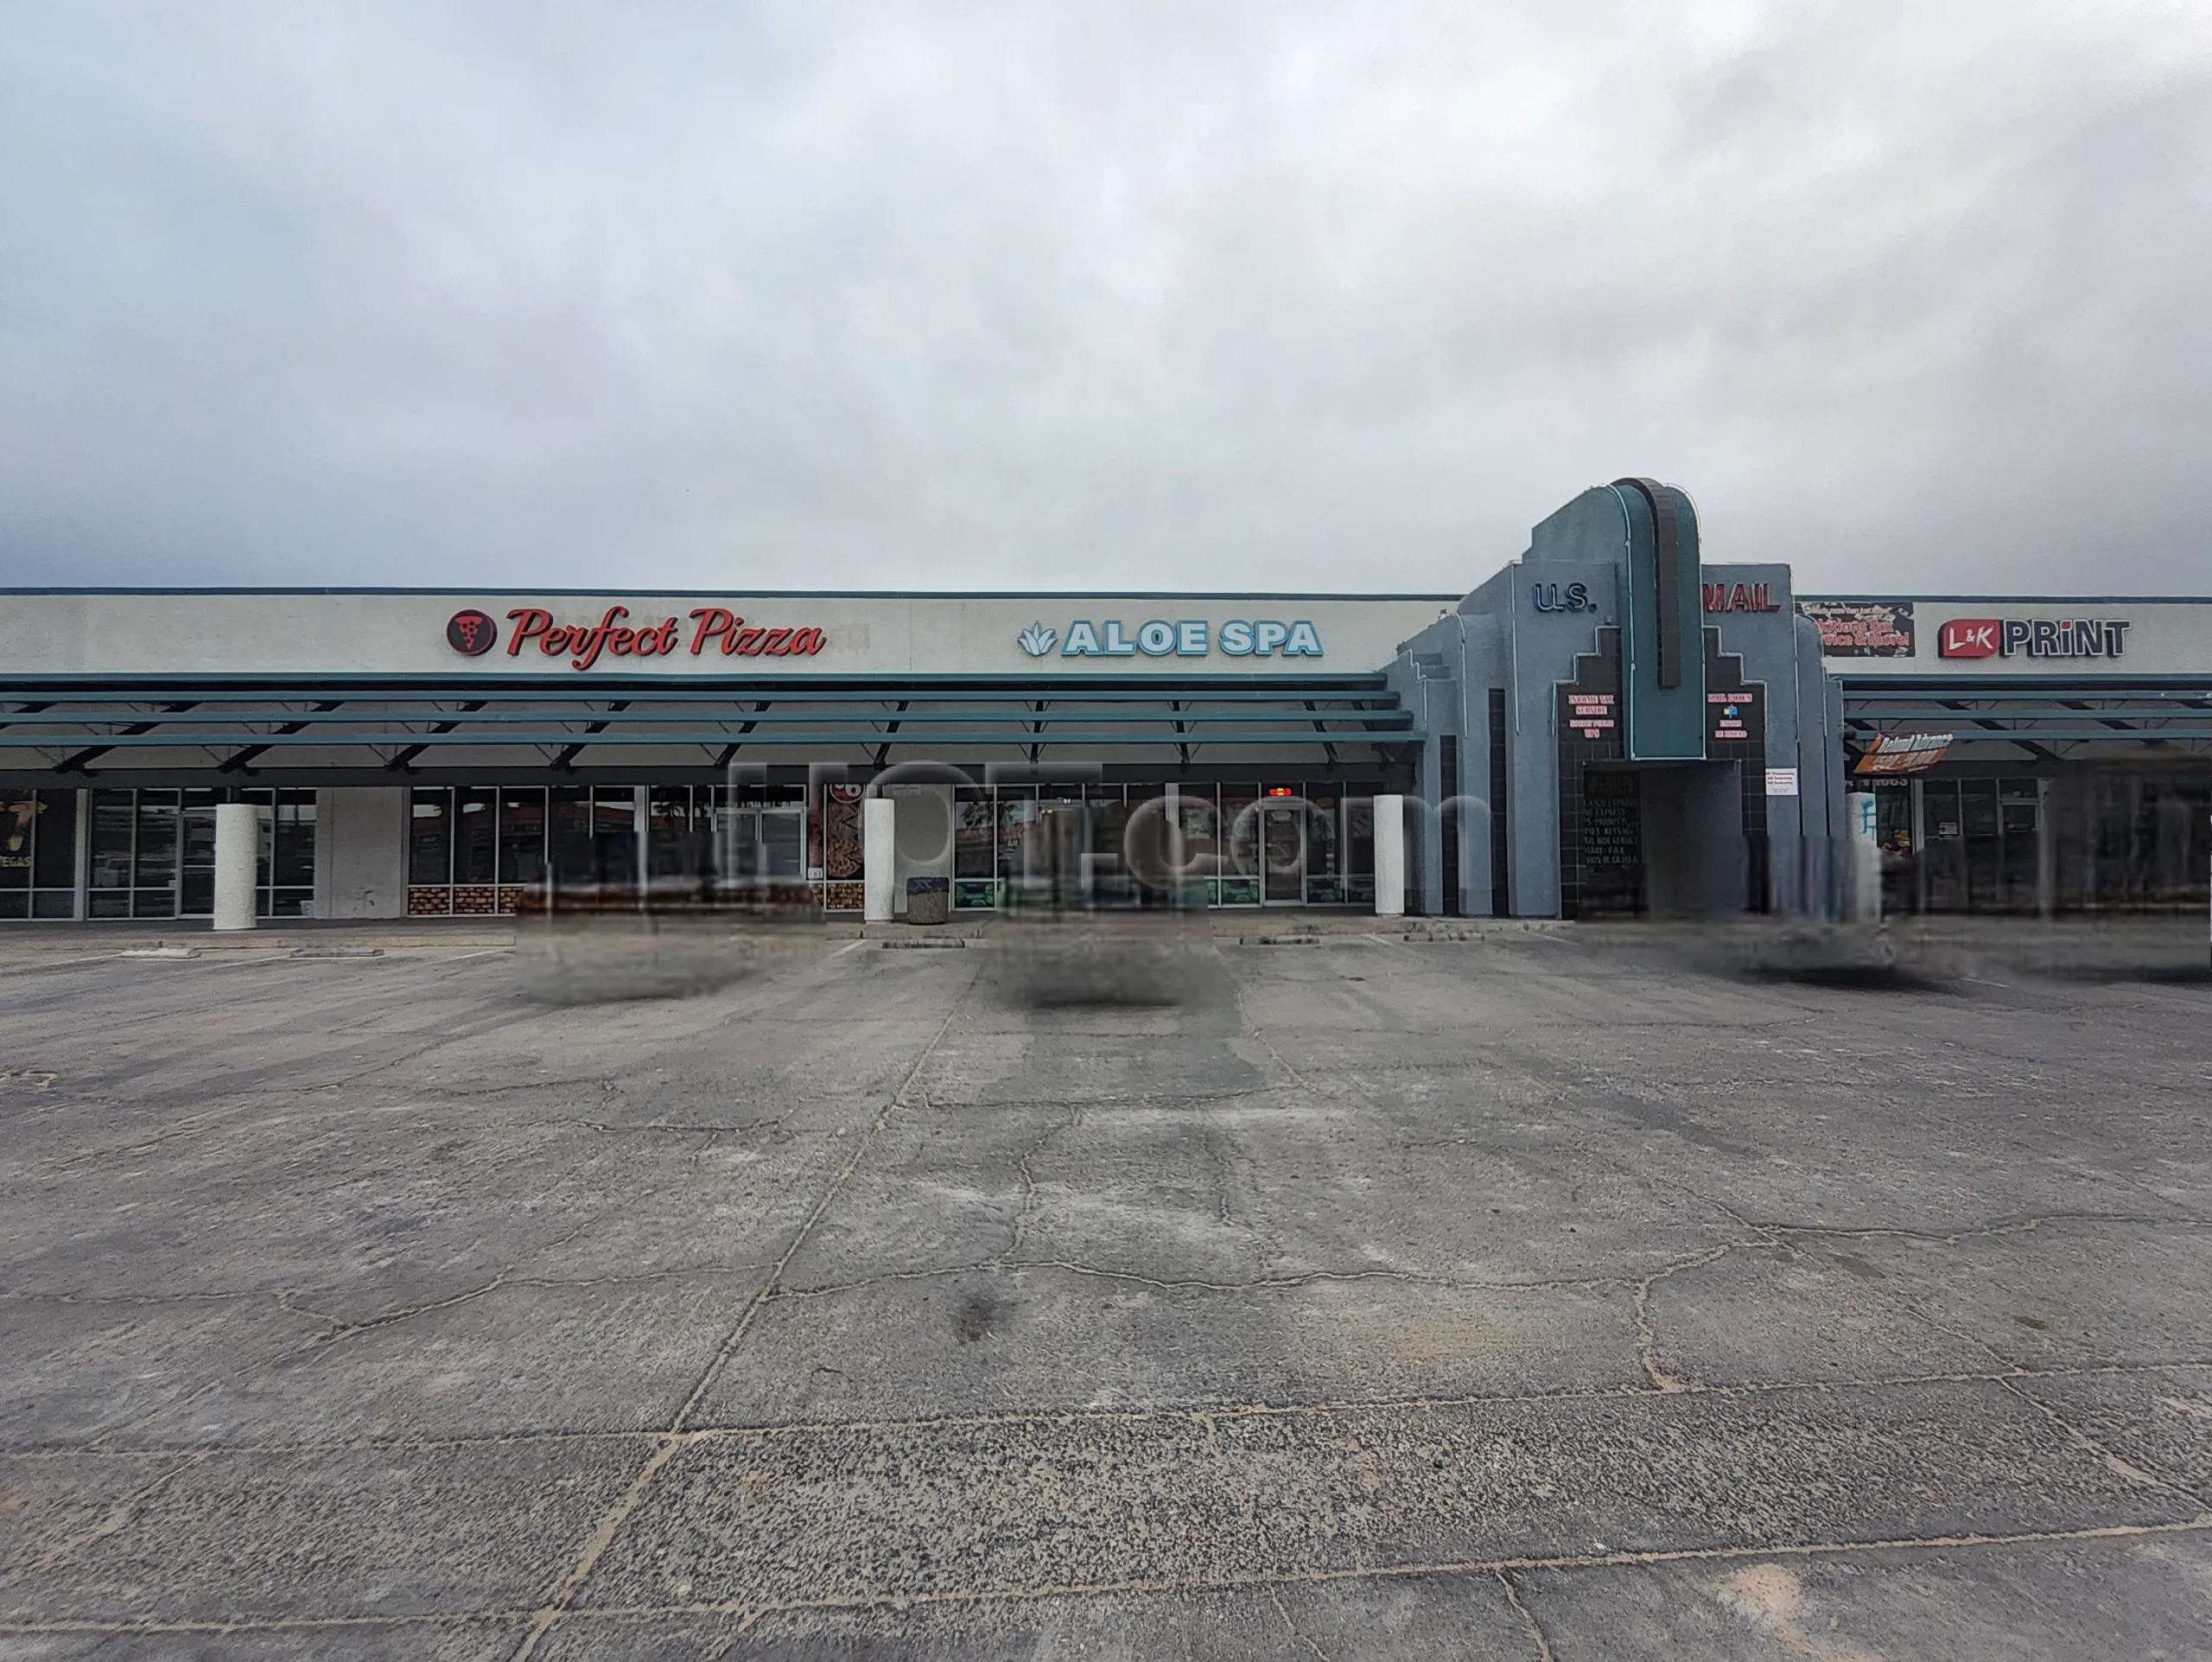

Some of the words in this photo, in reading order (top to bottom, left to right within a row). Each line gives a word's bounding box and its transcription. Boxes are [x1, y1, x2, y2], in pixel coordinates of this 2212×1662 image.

[1701, 583, 1780, 612] MAIL
[506, 605, 678, 671] Perfect
[689, 607, 827, 655] Pizza
[1061, 620, 1208, 657] ALOE
[1219, 620, 1325, 657] SPA
[1869, 618, 1895, 633] Tax
[1948, 626, 1995, 651] L&K
